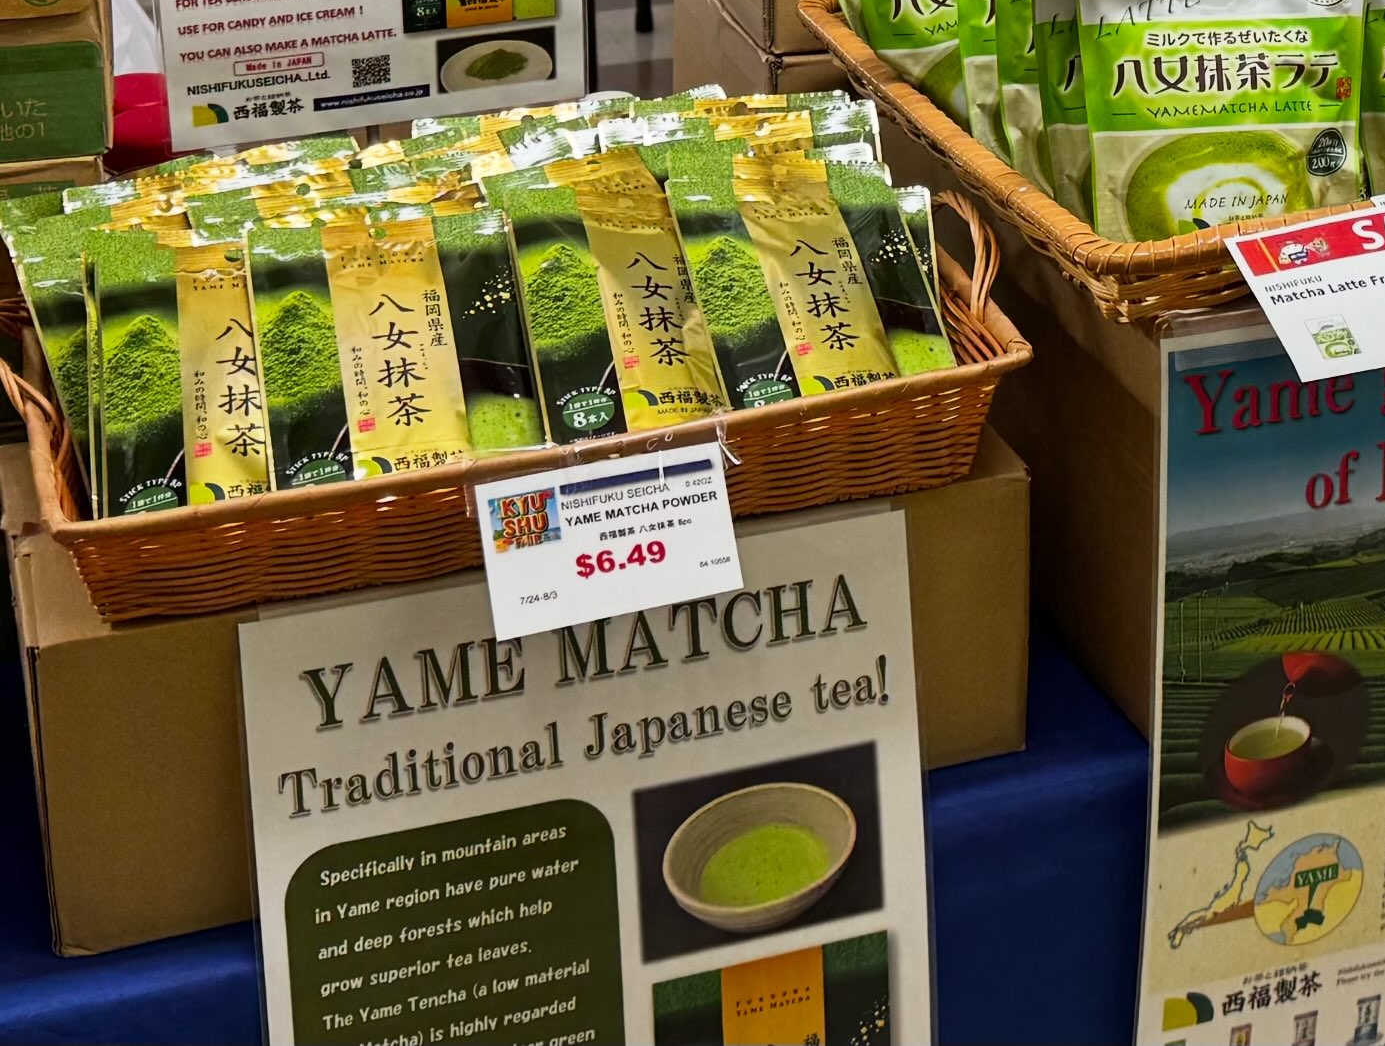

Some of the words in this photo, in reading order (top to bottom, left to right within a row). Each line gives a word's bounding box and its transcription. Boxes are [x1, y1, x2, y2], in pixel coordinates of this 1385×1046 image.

[175, 0, 198, 8] FOR
[180, 51, 204, 62] YOU
[207, 47, 231, 59] CAN
[234, 44, 262, 56] ALSO
[265, 40, 298, 52] MAKE
[300, 39, 308, 47] A
[311, 32, 359, 46] MATCHA
[362, 28, 397, 40] LATTE.
[1146, 29, 1309, 47] ミルクで作るぜいたくな
[1113, 53, 1339, 98] 八女抹茶ラテ
[234, 98, 304, 120] 西福製茶
[1146, 100, 1269, 117] YAMEMATCHA
[1274, 99, 1313, 114] LATTE
[1184, 194, 1225, 210] MADE
[1229, 194, 1245, 208] IN
[1248, 192, 1289, 209] JAPAN
[832, 237, 863, 286] 福岡県産
[791, 239, 860, 352] 八女抹茶
[1264, 274, 1323, 293] NISHIFUKU
[1270, 287, 1326, 307] Matcha
[1328, 276, 1367, 295] Latte
[423, 289, 448, 348] 福岡県産
[627, 251, 691, 367] 八女抹茶
[369, 293, 432, 428] 八女抹茶
[215, 318, 266, 457] 八女抹茶
[1184, 367, 1356, 436] Yame
[561, 490, 624, 511] NISHIFUKU
[627, 482, 670, 500] SEICHA
[1304, 450, 1360, 510] of
[500, 493, 547, 519] KYU
[565, 512, 602, 527] YAME
[605, 502, 659, 520] MATCHA
[662, 491, 718, 509] POWDER
[503, 512, 549, 539] SHU
[576, 541, 667, 579] $6.49
[520, 591, 557, 605] 7/24-8/3
[300, 634, 526, 731] YAME
[555, 573, 868, 687] MATCHA
[279, 721, 564, 819] Traditional
[585, 686, 793, 760] Japanese
[812, 655, 890, 713] tea!
[320, 856, 415, 887] Specifically
[421, 850, 436, 866] in
[442, 835, 517, 862] mountain
[523, 825, 567, 846] areas
[1295, 864, 1340, 889] YAME
[321, 975, 363, 998] grow
[370, 958, 440, 985] superior
[447, 952, 473, 968] tea
[478, 941, 532, 963] leaves.
[1222, 972, 1324, 1018] 西福製茶
